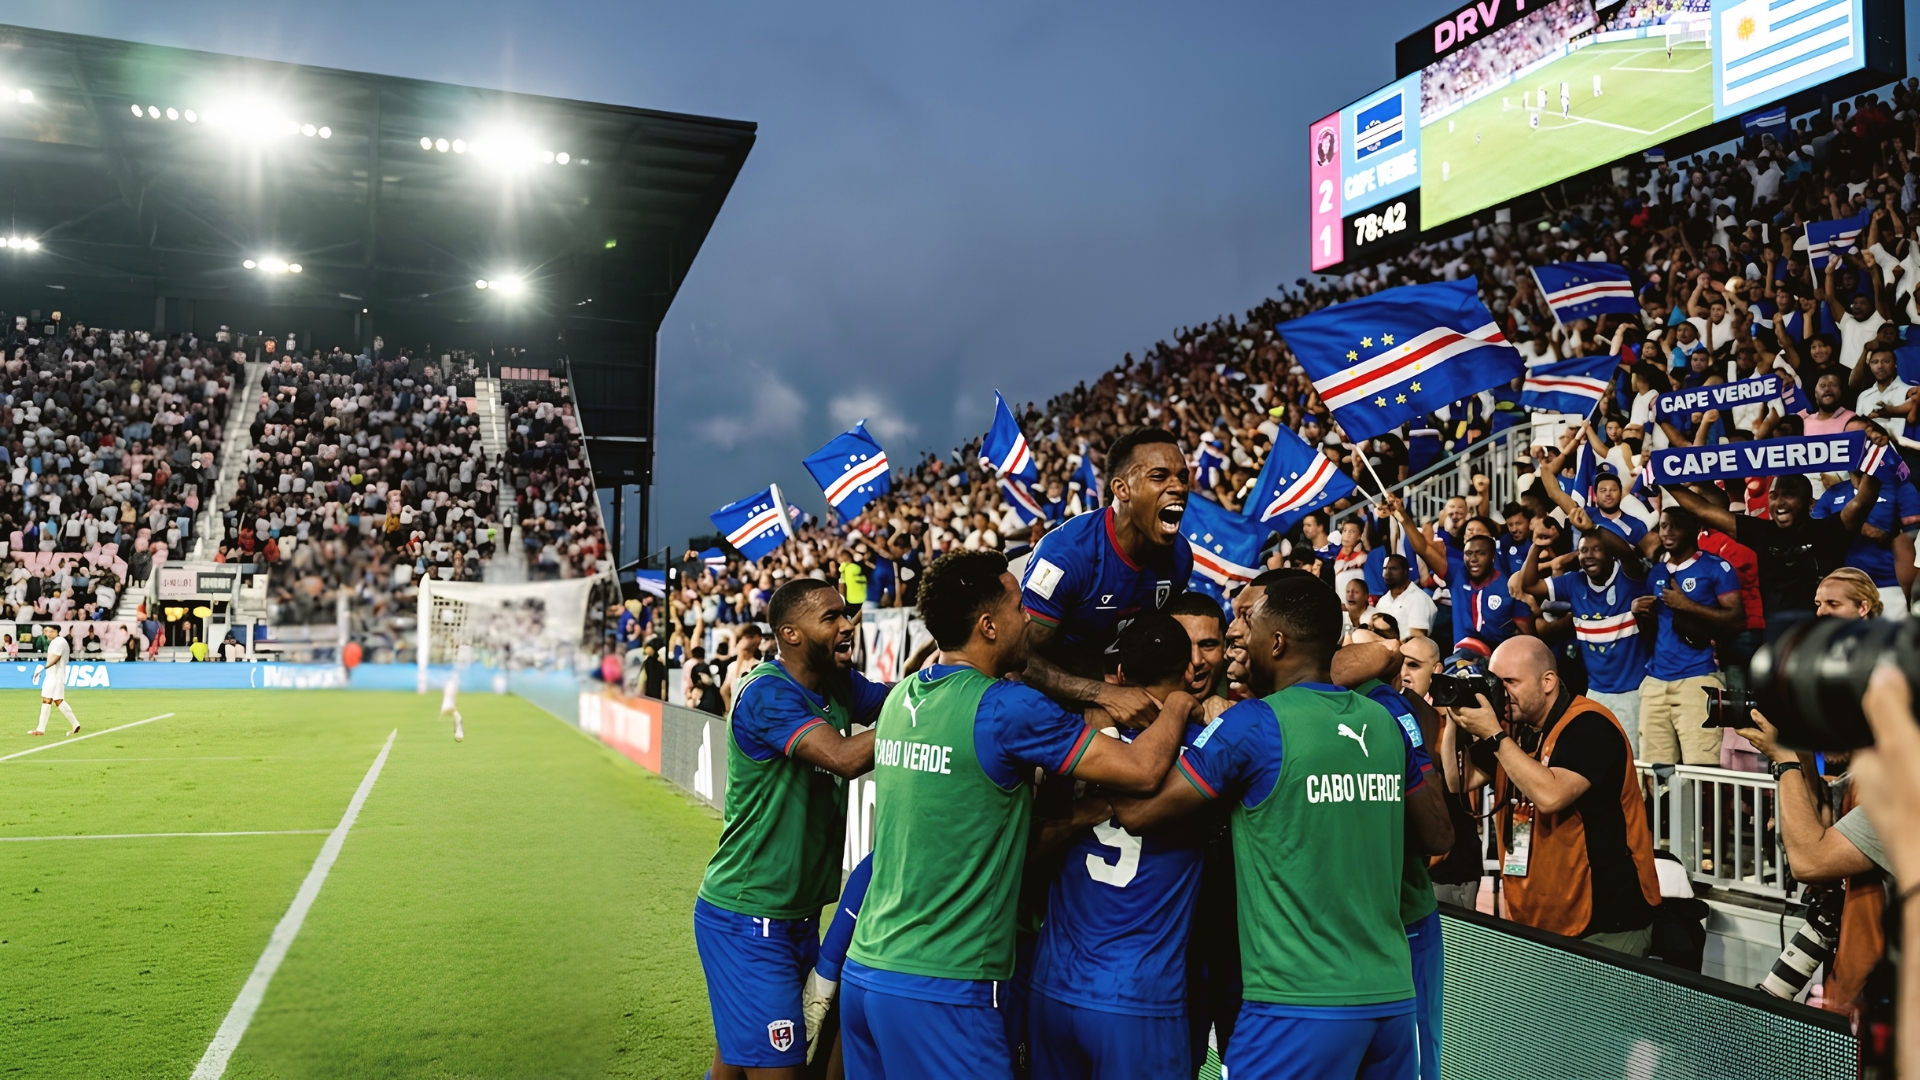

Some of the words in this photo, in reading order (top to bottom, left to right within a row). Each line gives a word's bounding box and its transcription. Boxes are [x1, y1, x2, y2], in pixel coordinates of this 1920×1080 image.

[1434, 0, 1500, 54] DRV
[1318, 179, 1334, 214] 2
[1319, 224, 1331, 257] 1
[1354, 201, 1407, 246] 78:42
[1660, 391, 1709, 413] CAPE
[1712, 377, 1777, 405] VERDE
[1662, 449, 1738, 477] CAPE
[1744, 439, 1850, 470] VERDE
[903, 741, 953, 775] VERDE
[1306, 773, 1355, 804] CABO
[1356, 773, 1402, 802] VERDE
